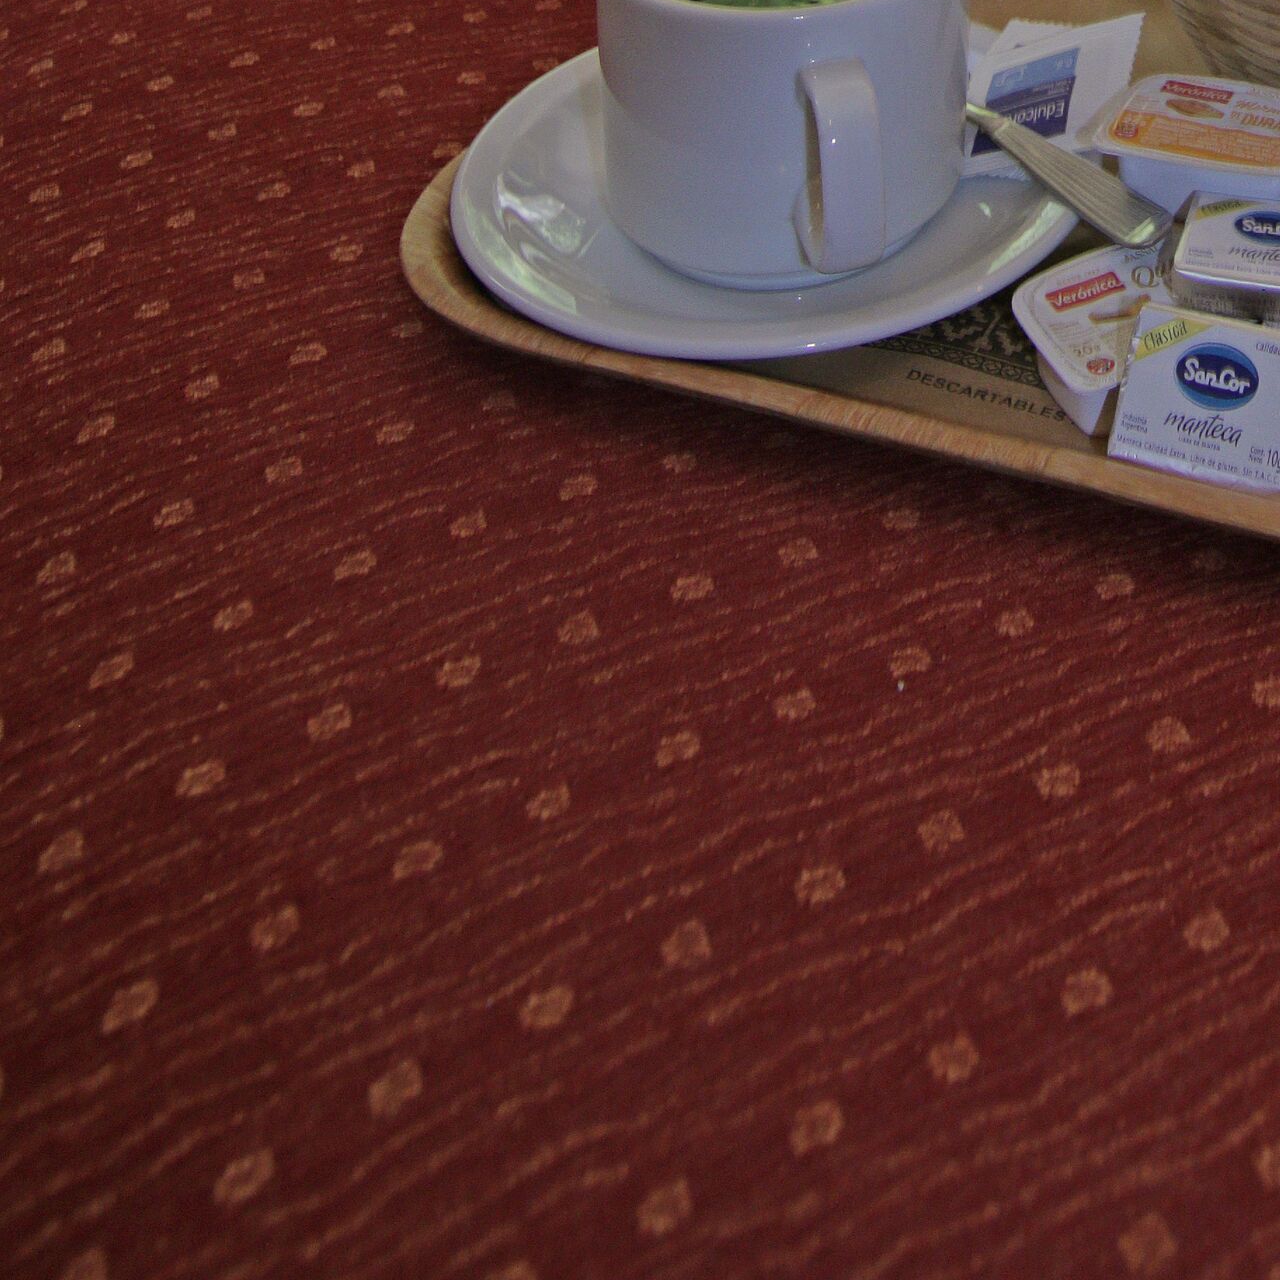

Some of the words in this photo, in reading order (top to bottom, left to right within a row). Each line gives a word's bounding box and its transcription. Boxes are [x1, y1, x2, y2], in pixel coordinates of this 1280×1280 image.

[1010, 99, 1065, 123] Edulcor
[1053, 276, 1126, 307] Verónica
[1183, 356, 1250, 394] SanCor
[906, 368, 1066, 422] DESCARTABLES
[1120, 420, 1149, 434] Argentina
[1163, 411, 1244, 447] manteca
[1190, 454, 1206, 466] Libre
